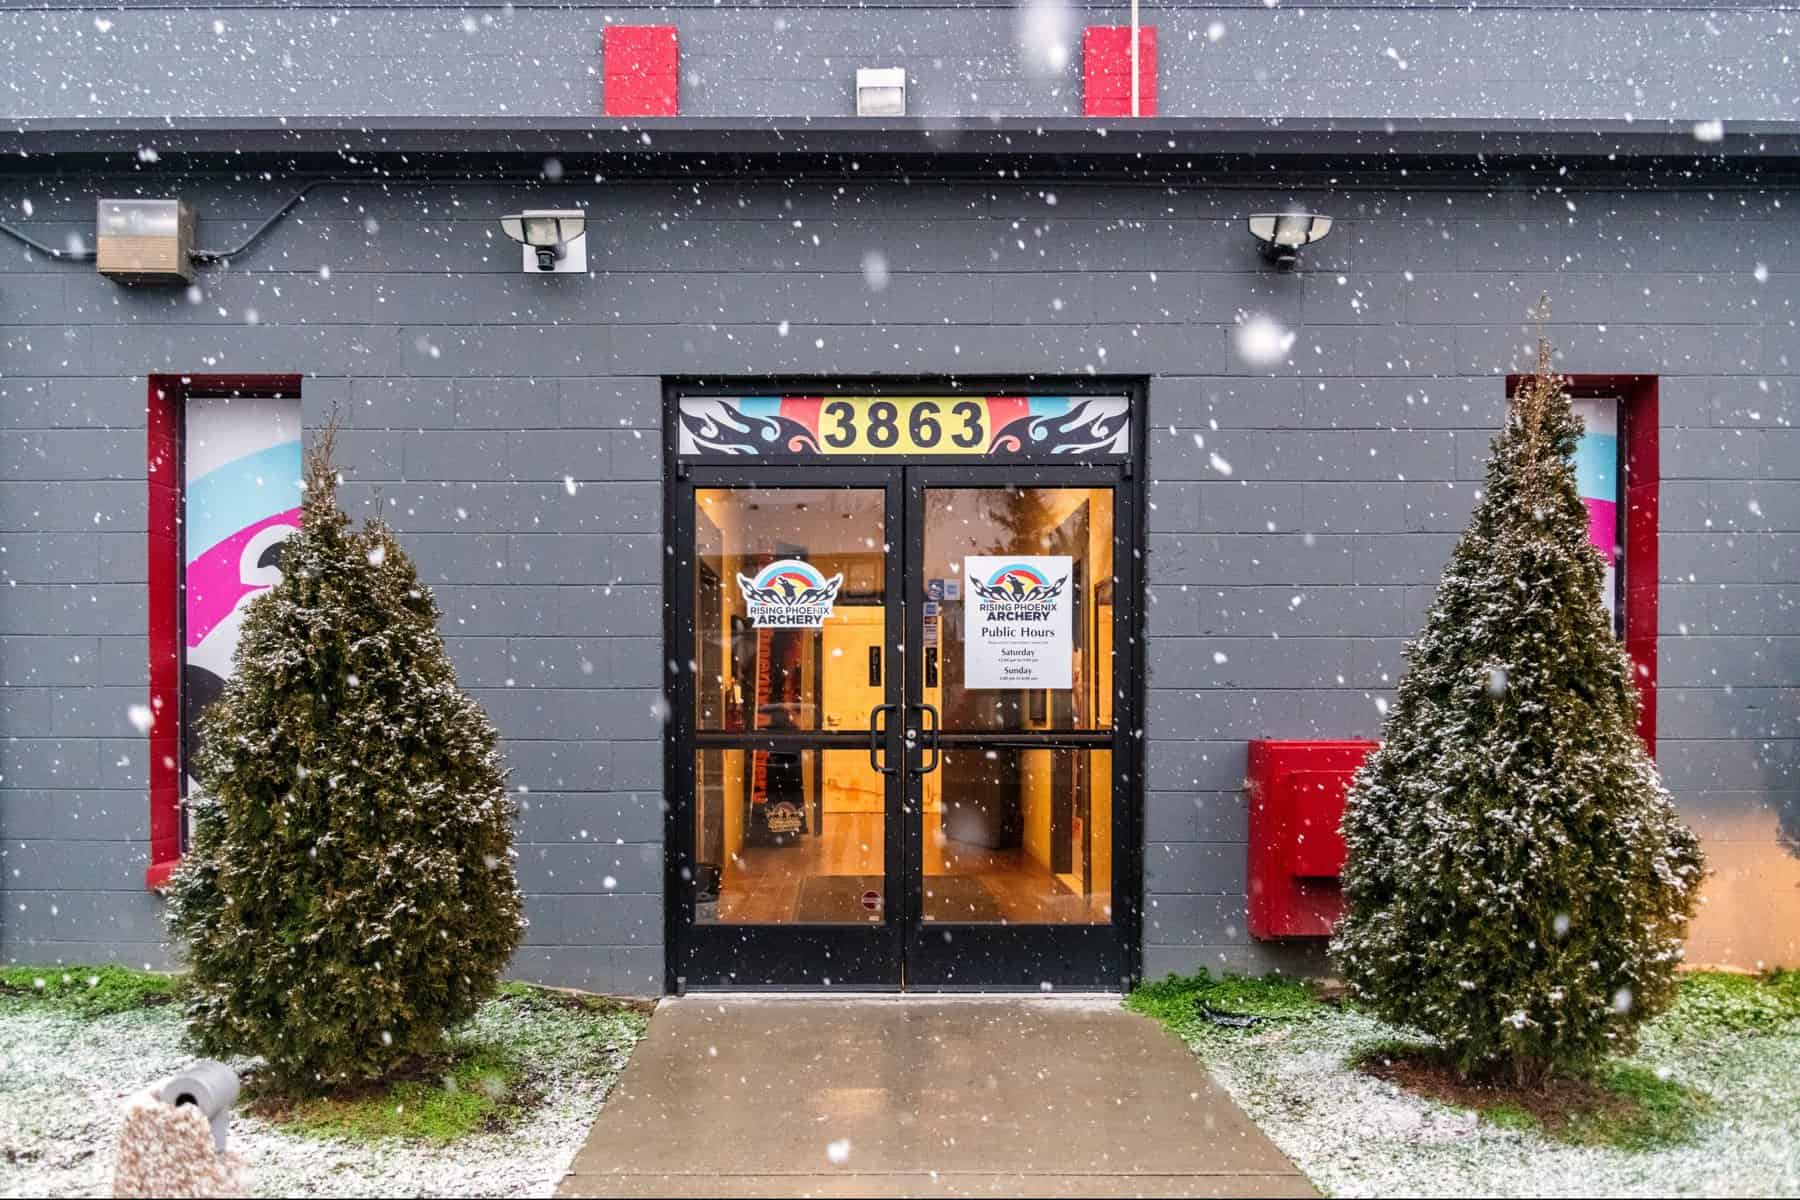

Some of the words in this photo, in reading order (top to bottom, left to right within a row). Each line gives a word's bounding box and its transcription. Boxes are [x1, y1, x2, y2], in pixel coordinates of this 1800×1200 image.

[824, 401, 984, 449] 3863
[750, 606, 783, 615] RISING
[785, 606, 830, 615] PHOENIX
[979, 603, 1012, 611] RISING
[1014, 603, 1057, 611] PHOENIX
[758, 615, 822, 625] ARCHERY
[987, 611, 1050, 621] ARCHERY
[982, 626, 1016, 637] Public
[1020, 626, 1056, 637] Hours
[1001, 648, 1035, 657] Saturday
[1004, 666, 1032, 676] Sunday
